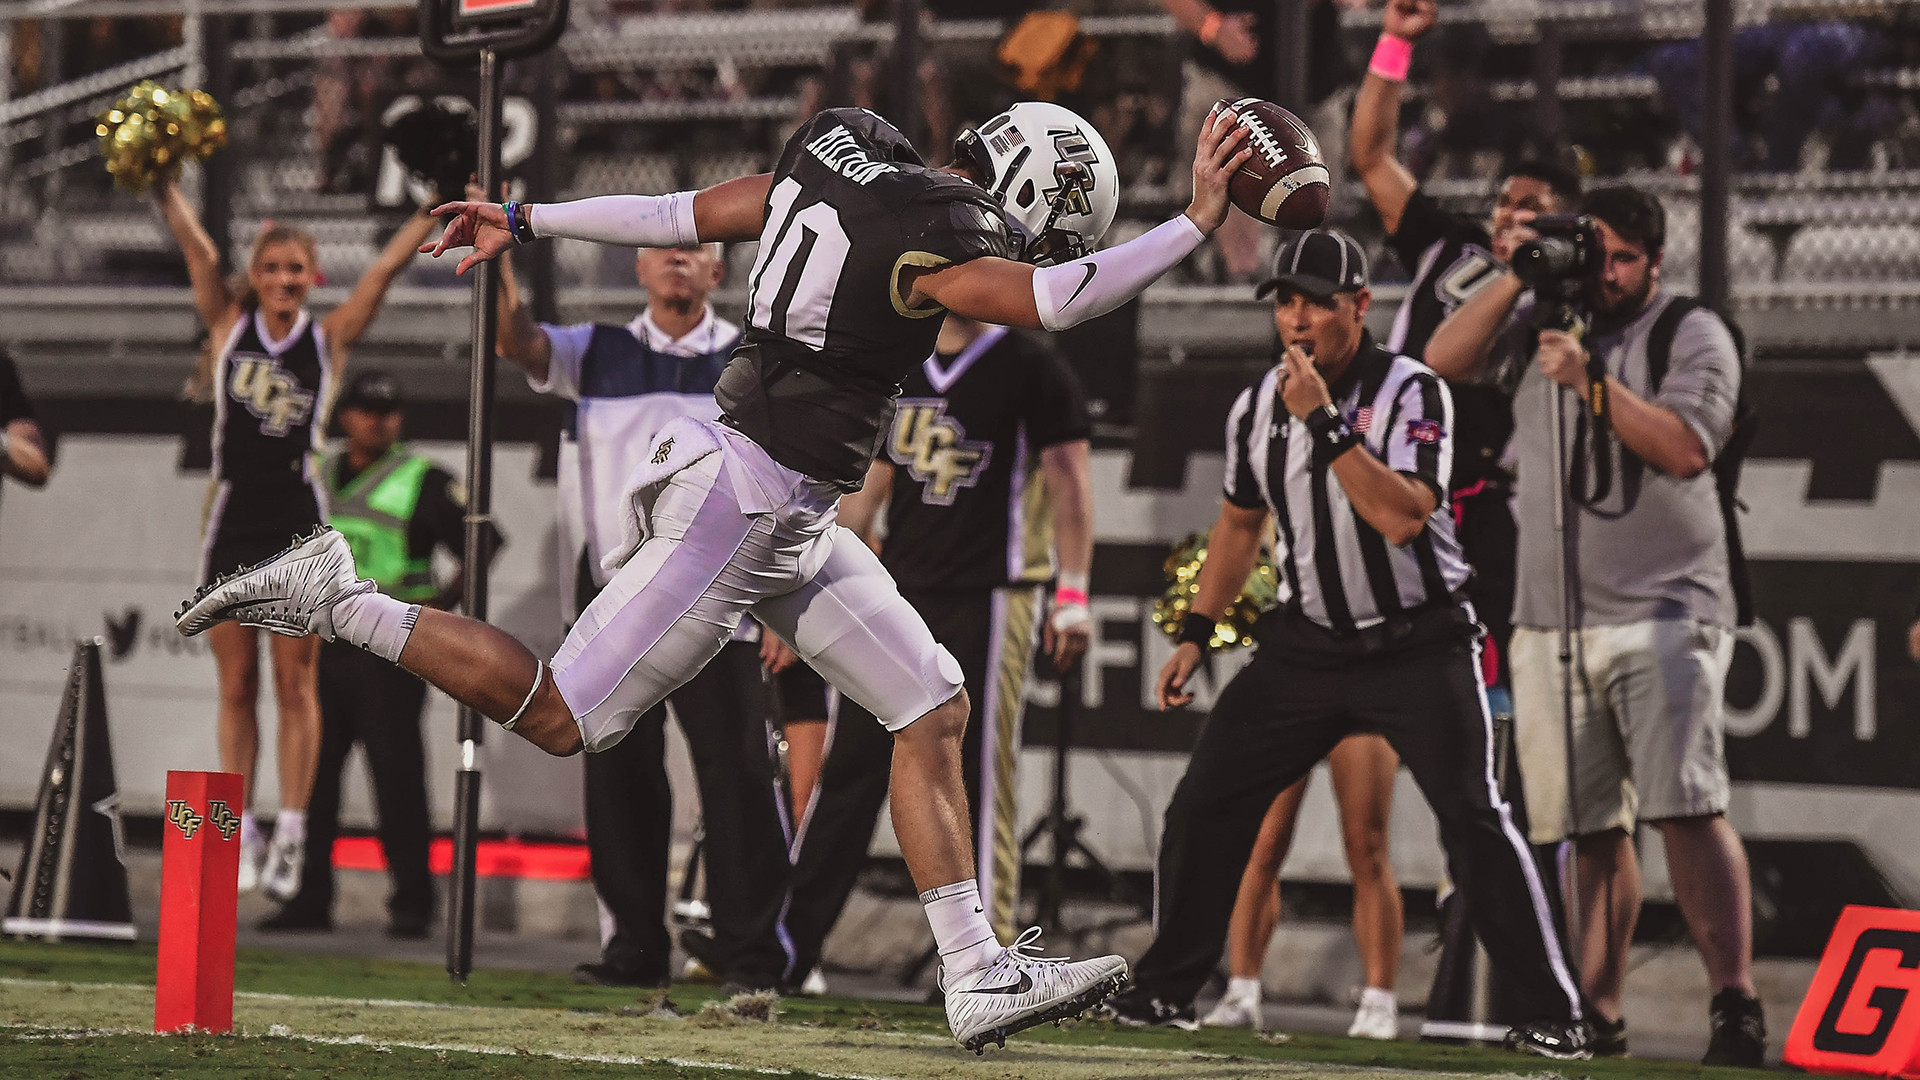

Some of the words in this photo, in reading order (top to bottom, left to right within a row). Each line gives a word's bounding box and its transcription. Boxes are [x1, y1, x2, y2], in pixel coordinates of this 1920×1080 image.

[805, 124, 899, 186] MILTON
[748, 176, 851, 351] 10
[228, 351, 315, 437] UCF
[887, 398, 995, 506] UCF
[167, 800, 204, 840] UCF
[208, 800, 241, 841] UCF
[1812, 928, 1920, 1056] G
